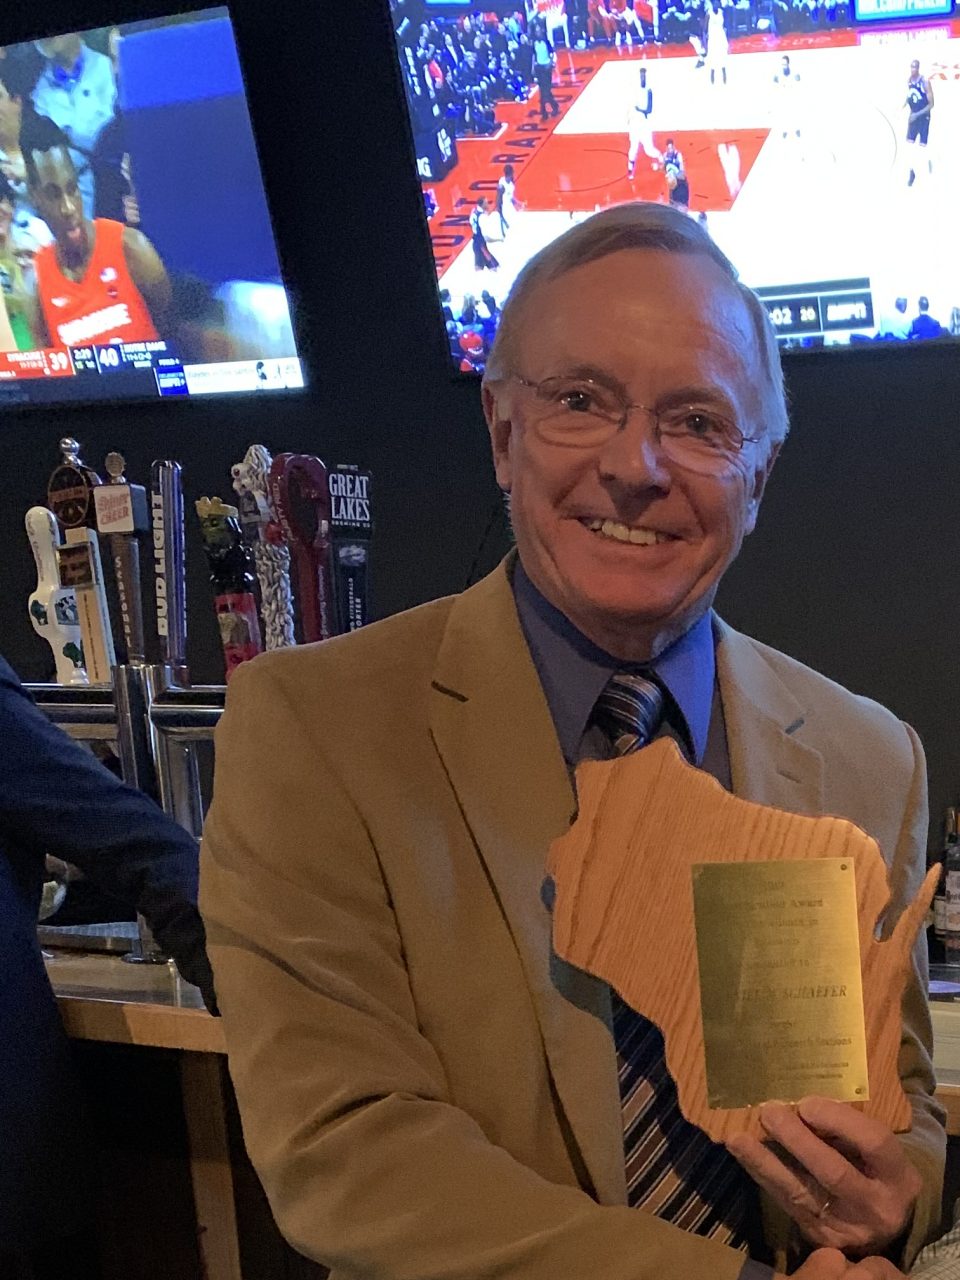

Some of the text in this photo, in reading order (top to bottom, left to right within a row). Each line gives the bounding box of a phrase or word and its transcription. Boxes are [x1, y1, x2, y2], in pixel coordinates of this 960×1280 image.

[49, 352, 68, 370] 39
[99, 348, 119, 367] 40
[328, 473, 369, 499] GREAT
[331, 496, 370, 521] LAKES
[151, 490, 168, 636] BUD LIGHT
